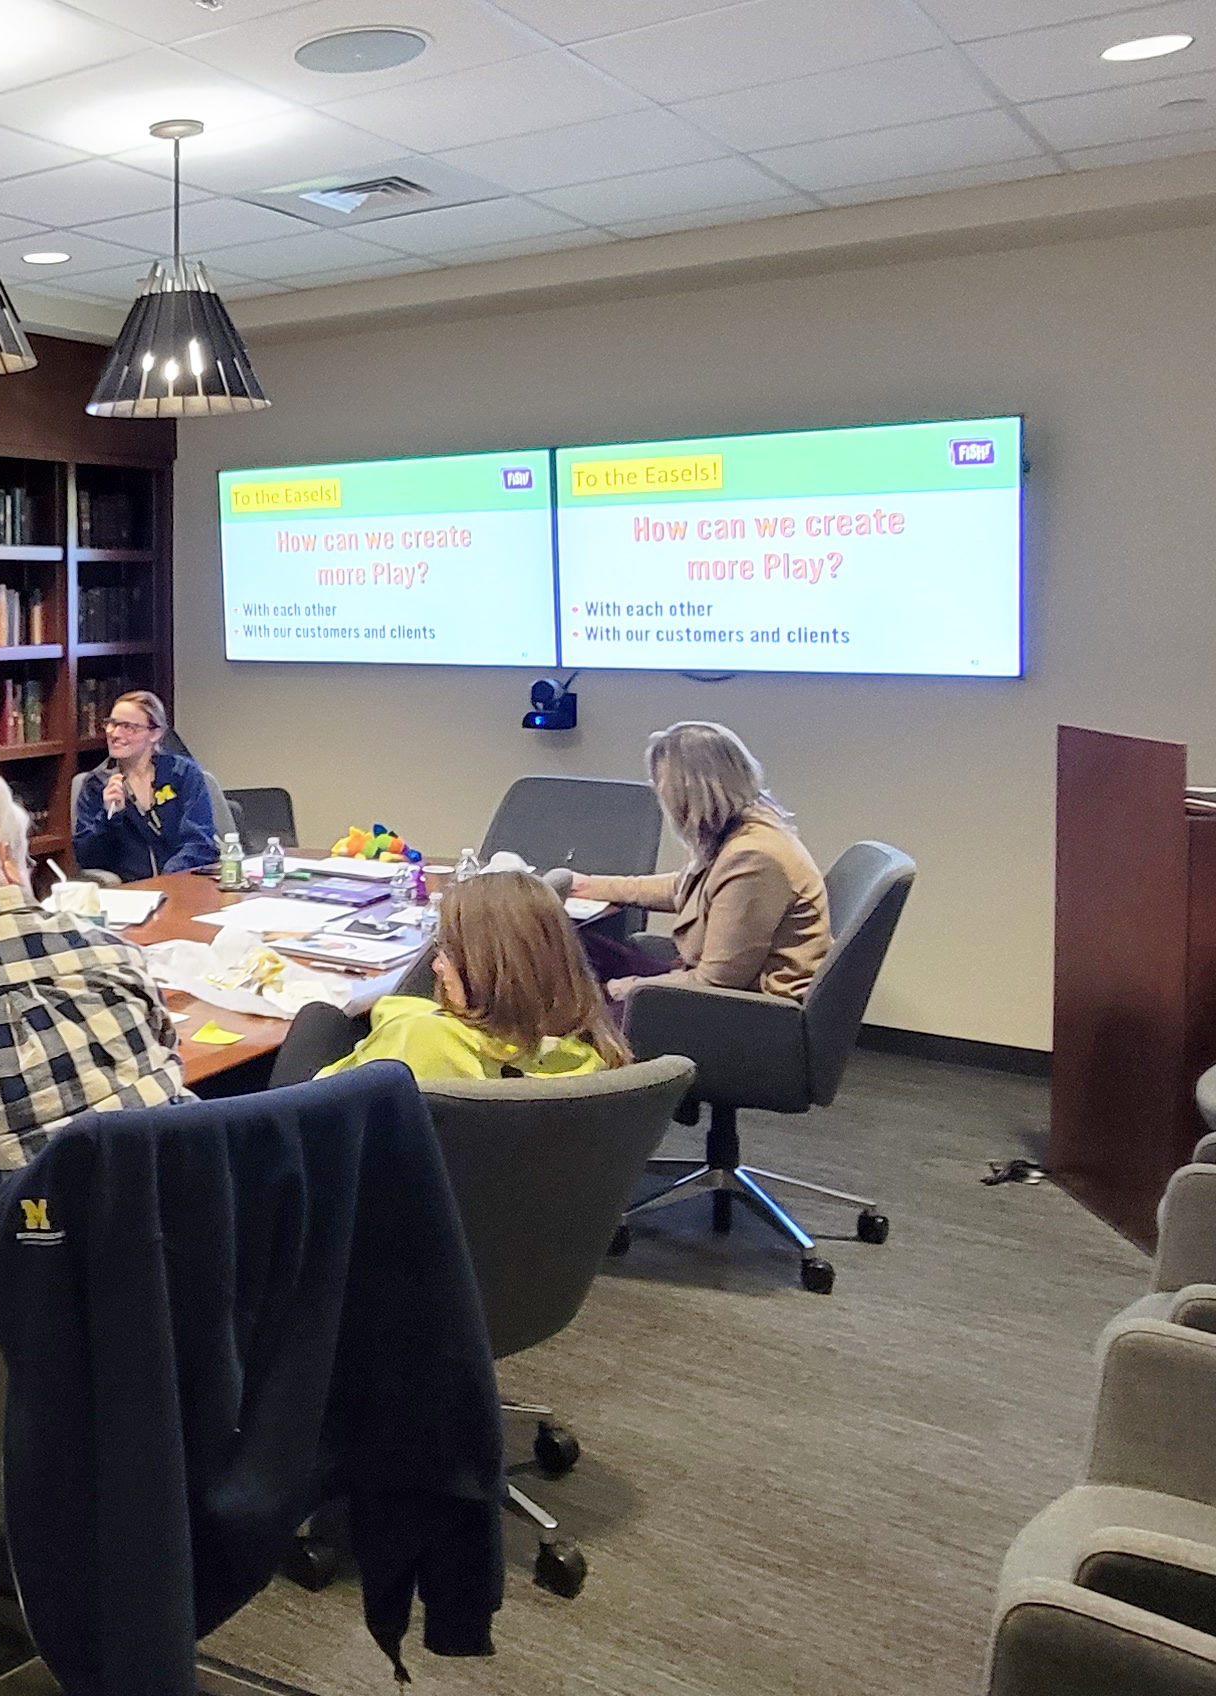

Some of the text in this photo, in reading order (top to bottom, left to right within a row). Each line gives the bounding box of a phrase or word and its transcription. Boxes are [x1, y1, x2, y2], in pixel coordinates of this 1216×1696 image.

[574, 462, 718, 487] To the Easels!
[233, 485, 337, 507] To the Easels!
[634, 509, 905, 542] How can we create
[277, 525, 472, 553] How can we create
[318, 561, 429, 589] more Play?
[688, 552, 843, 584] more Play?
[243, 603, 337, 617] With each other
[585, 601, 713, 618] With each other
[243, 624, 436, 640] With our customers and clients
[585, 626, 850, 644] With our customers and clients
